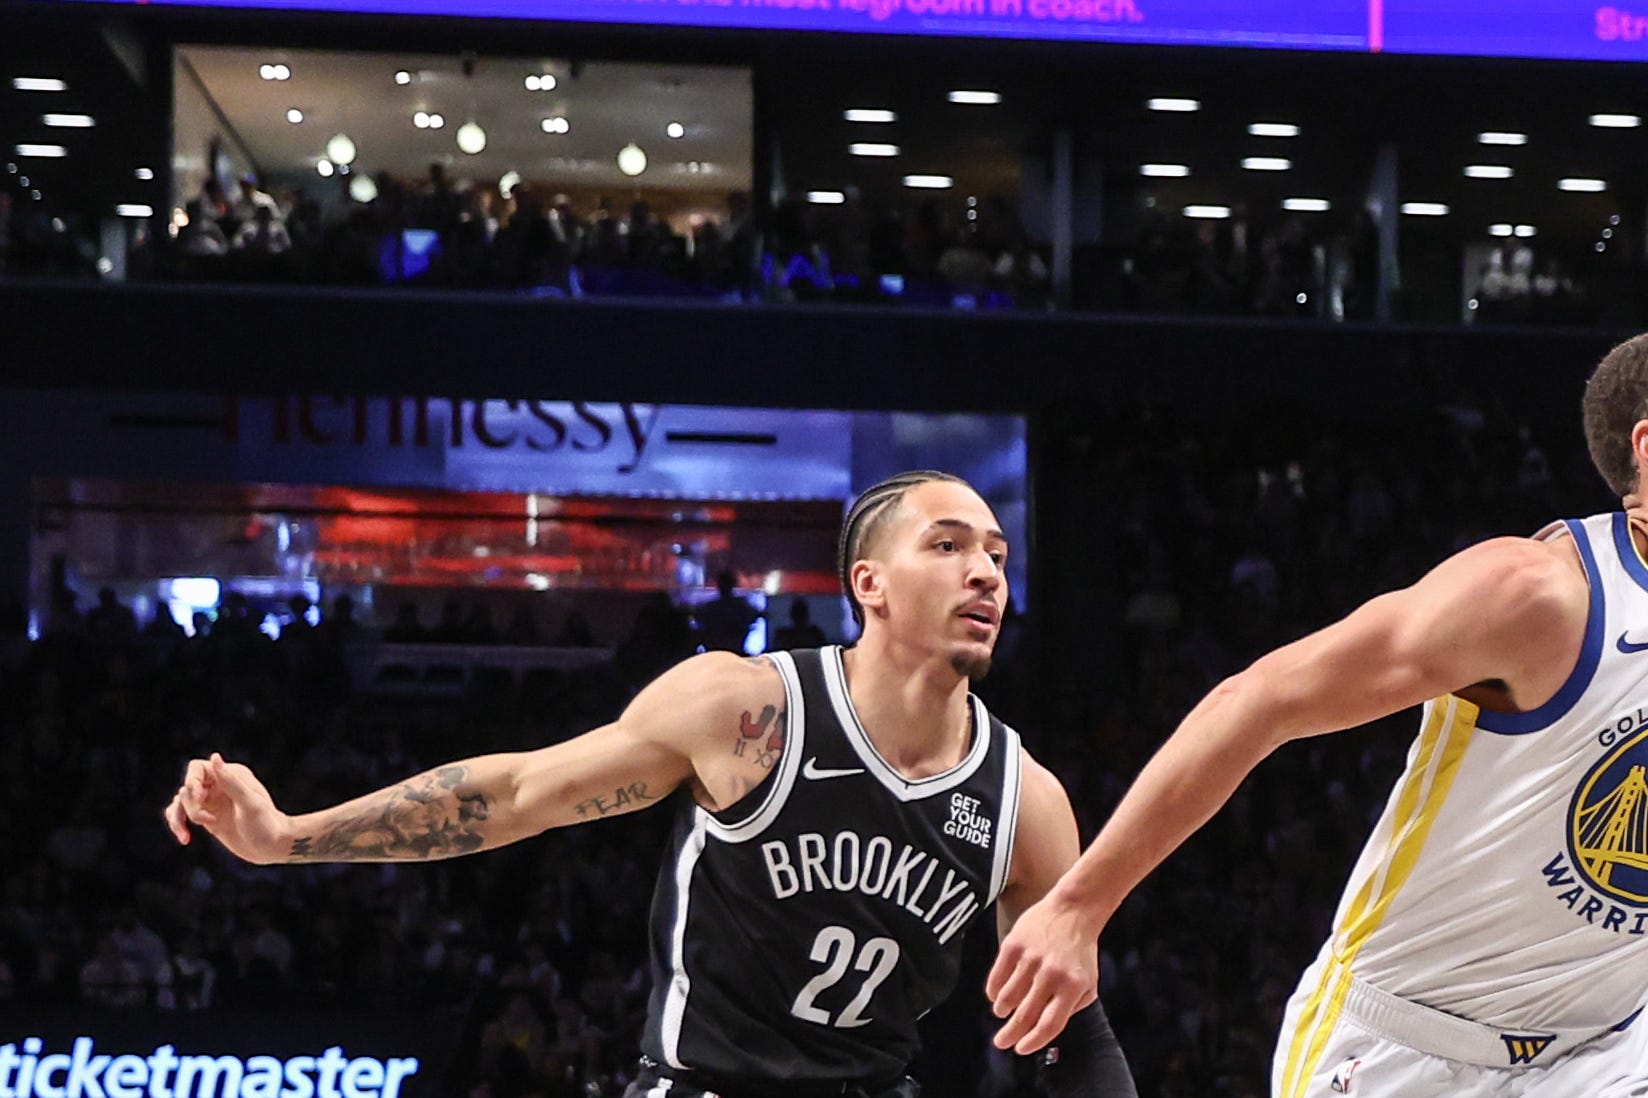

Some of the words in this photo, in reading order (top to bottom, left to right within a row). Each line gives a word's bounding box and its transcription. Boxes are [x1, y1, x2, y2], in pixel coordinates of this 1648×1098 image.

[951, 792, 981, 814] GET
[950, 806, 992, 833] YOUR
[943, 820, 991, 848] GUIDE
[762, 831, 979, 945] BROOKLYN
[791, 925, 900, 1029] 22
